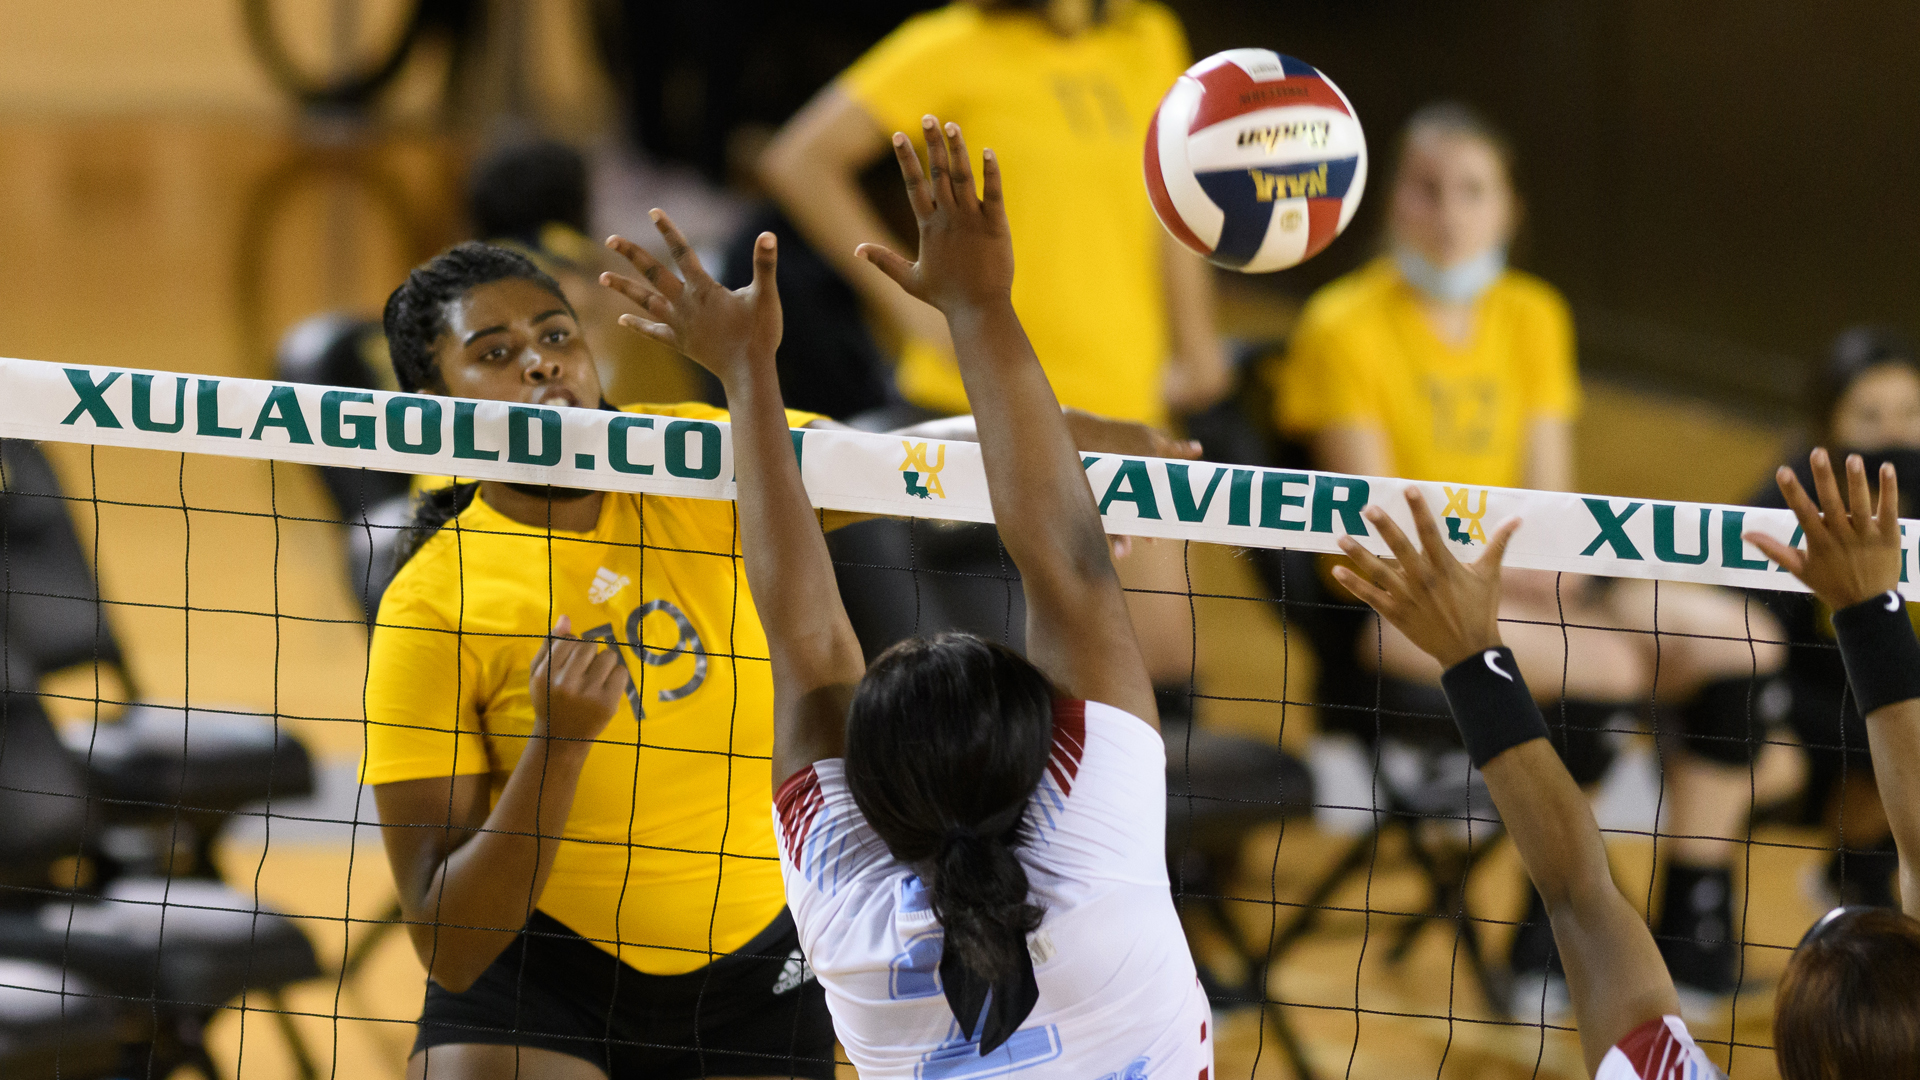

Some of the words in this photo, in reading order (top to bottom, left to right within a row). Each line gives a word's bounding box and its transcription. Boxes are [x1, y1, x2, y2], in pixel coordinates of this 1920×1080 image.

[60, 367, 805, 482] XULAGOLD.CO
[1082, 456, 1370, 536] AVIER
[582, 600, 708, 722] 19
